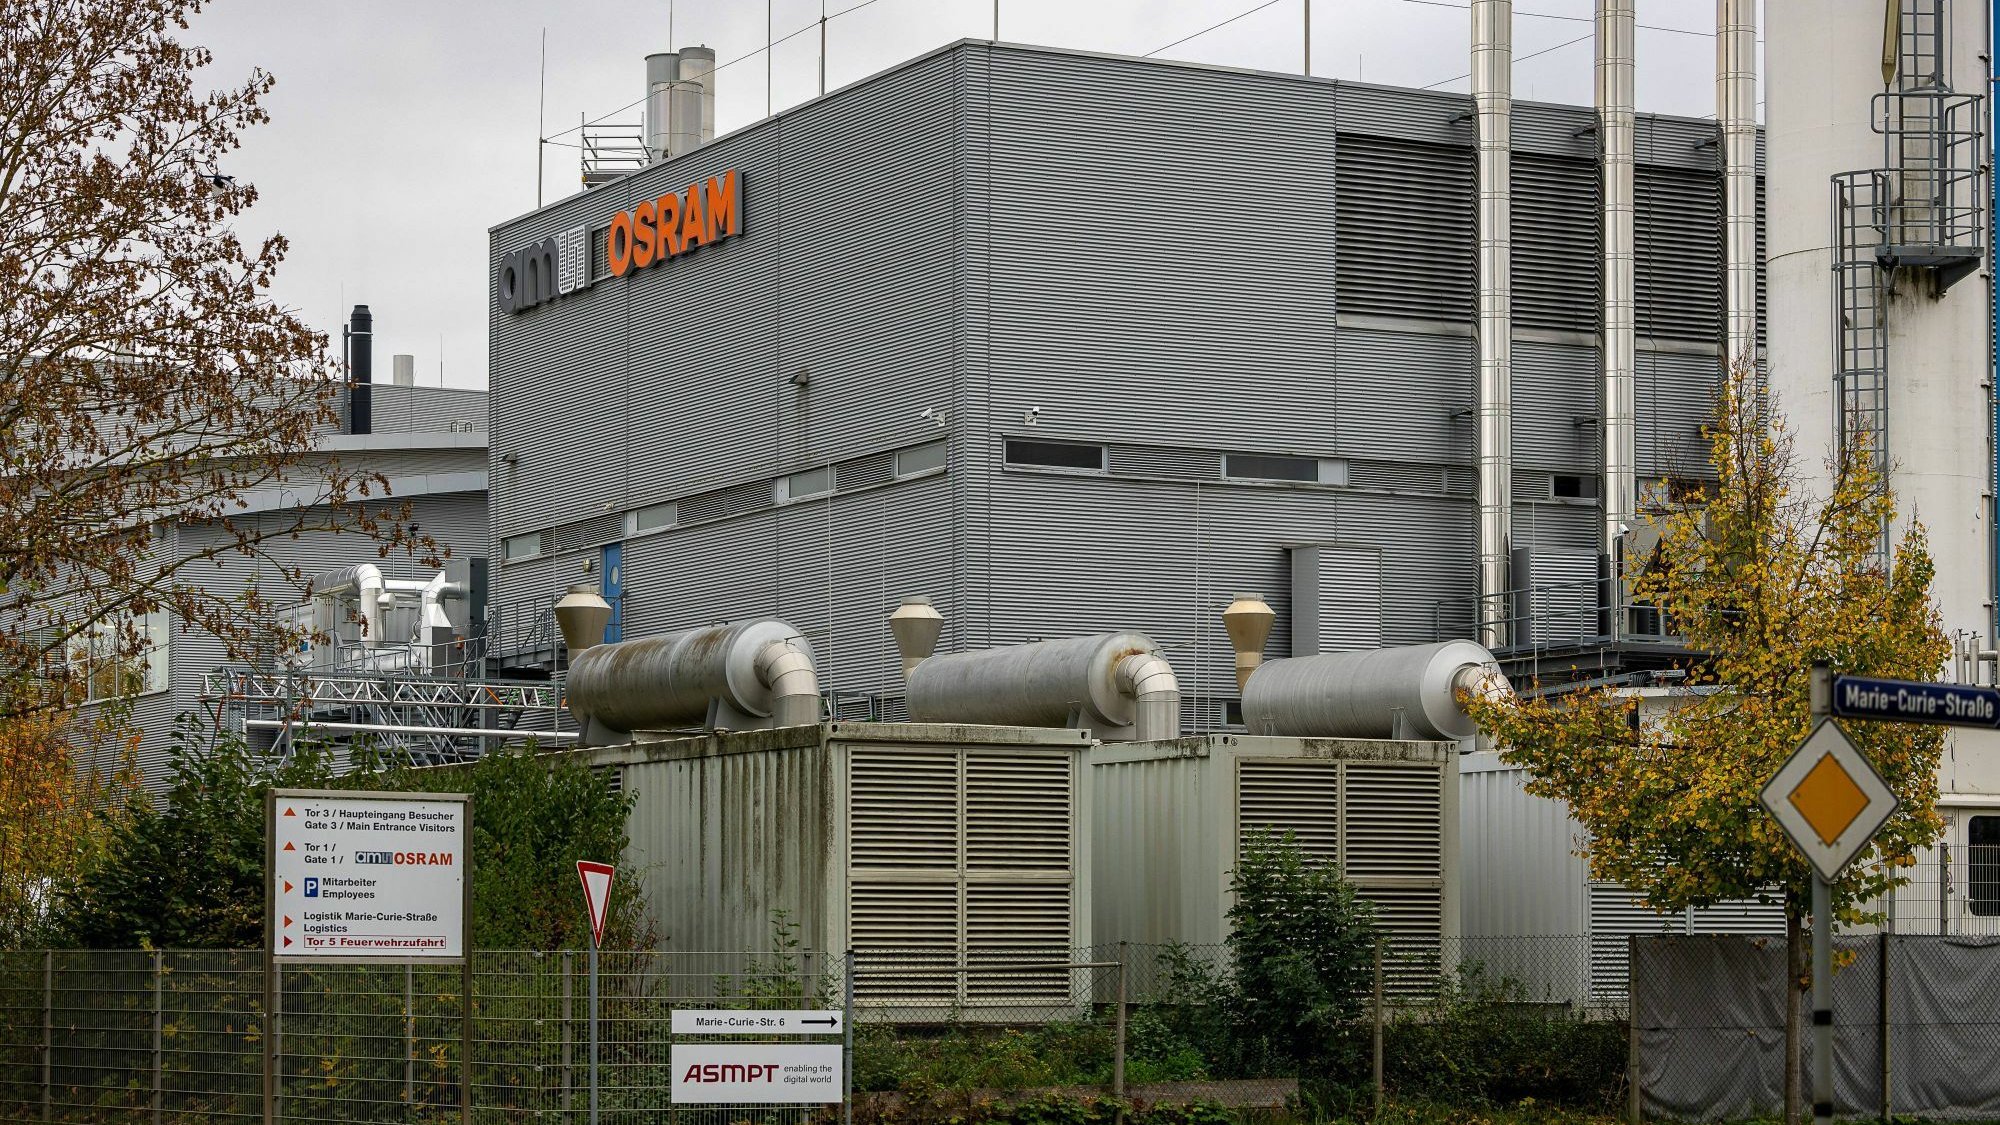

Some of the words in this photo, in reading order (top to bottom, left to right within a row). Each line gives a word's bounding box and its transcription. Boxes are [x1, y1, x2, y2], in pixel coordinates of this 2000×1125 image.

[608, 168, 743, 277] OSRAM
[1845, 685, 1993, 718] Marie-Curie-Straße
[305, 809, 320, 817] Tor
[323, 809, 329, 817] 3
[339, 810, 406, 821] Haupteingang
[409, 811, 454, 821] Besucher
[305, 822, 328, 830] Gate
[331, 822, 337, 830] 3
[347, 822, 370, 831] Main
[373, 823, 416, 831] Entrance
[420, 823, 455, 832] Visitors
[305, 843, 320, 851] Tor
[323, 843, 328, 851] 1
[305, 856, 327, 864] Gate
[331, 856, 336, 864] 1
[394, 852, 452, 865] OSRAM
[323, 878, 376, 887] Mitarbeiter
[306, 881, 317, 894] P
[323, 890, 375, 899] Employees
[304, 912, 342, 922] Logistik
[345, 912, 437, 922] Marie-Curie-Straße
[304, 924, 347, 933] Logistics
[307, 938, 324, 946] Tor
[329, 938, 336, 946] 5
[341, 938, 444, 947] Feuerwehrzufahrt
[696, 1018, 776, 1026] Marie-Curie-Str.
[779, 1018, 785, 1026] 6
[683, 1065, 779, 1082] ASMPT
[784, 1065, 817, 1073] enabling
[784, 1076, 807, 1084] digital
